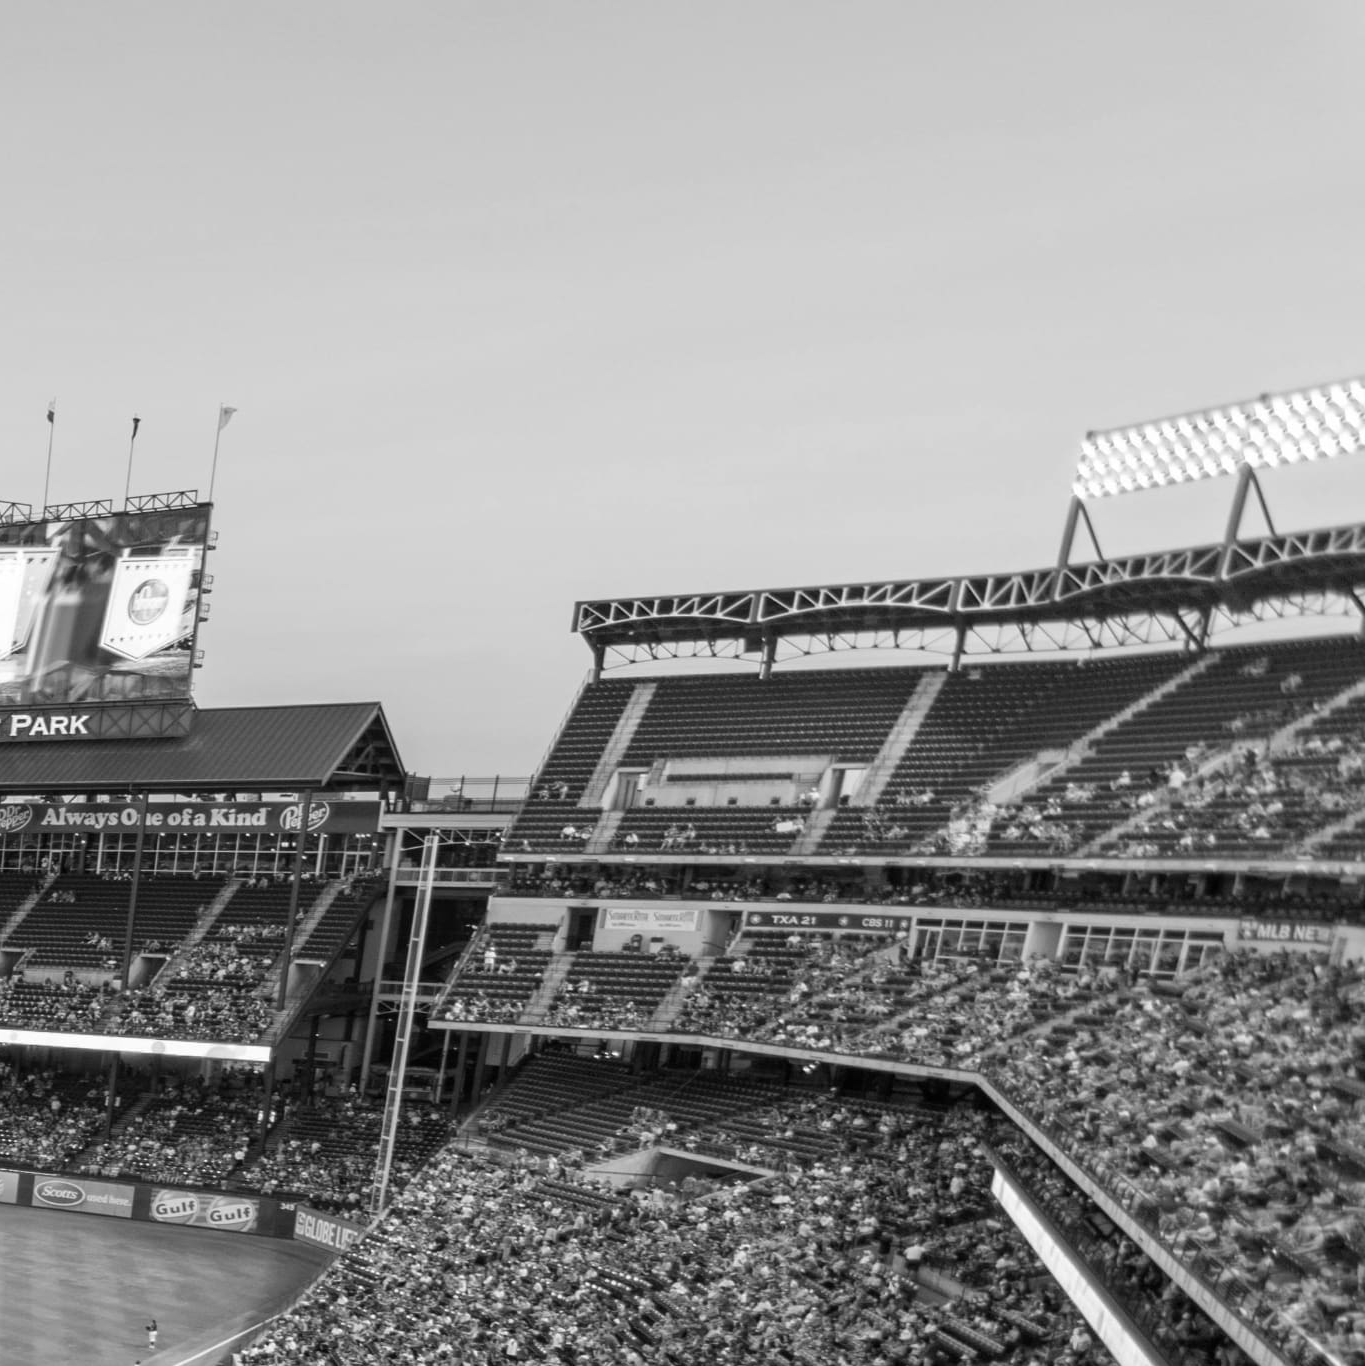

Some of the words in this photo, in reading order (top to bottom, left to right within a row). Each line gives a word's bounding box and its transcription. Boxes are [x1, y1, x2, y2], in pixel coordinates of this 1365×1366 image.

[10, 714, 90, 737] PARK
[41, 808, 118, 829] Always
[167, 808, 191, 826] of
[192, 813, 206, 826] a
[209, 808, 266, 826] Kind
[771, 915, 797, 926] TXA
[801, 916, 817, 926] 21
[862, 918, 883, 929] CBS
[885, 918, 894, 929] 11
[1257, 923, 1290, 939] MLB
[41, 1186, 78, 1200] Scotts
[87, 1194, 107, 1204] used
[155, 1201, 196, 1216] Gulf
[209, 1207, 251, 1223] Gulf
[304, 1215, 336, 1247] GLOBE
